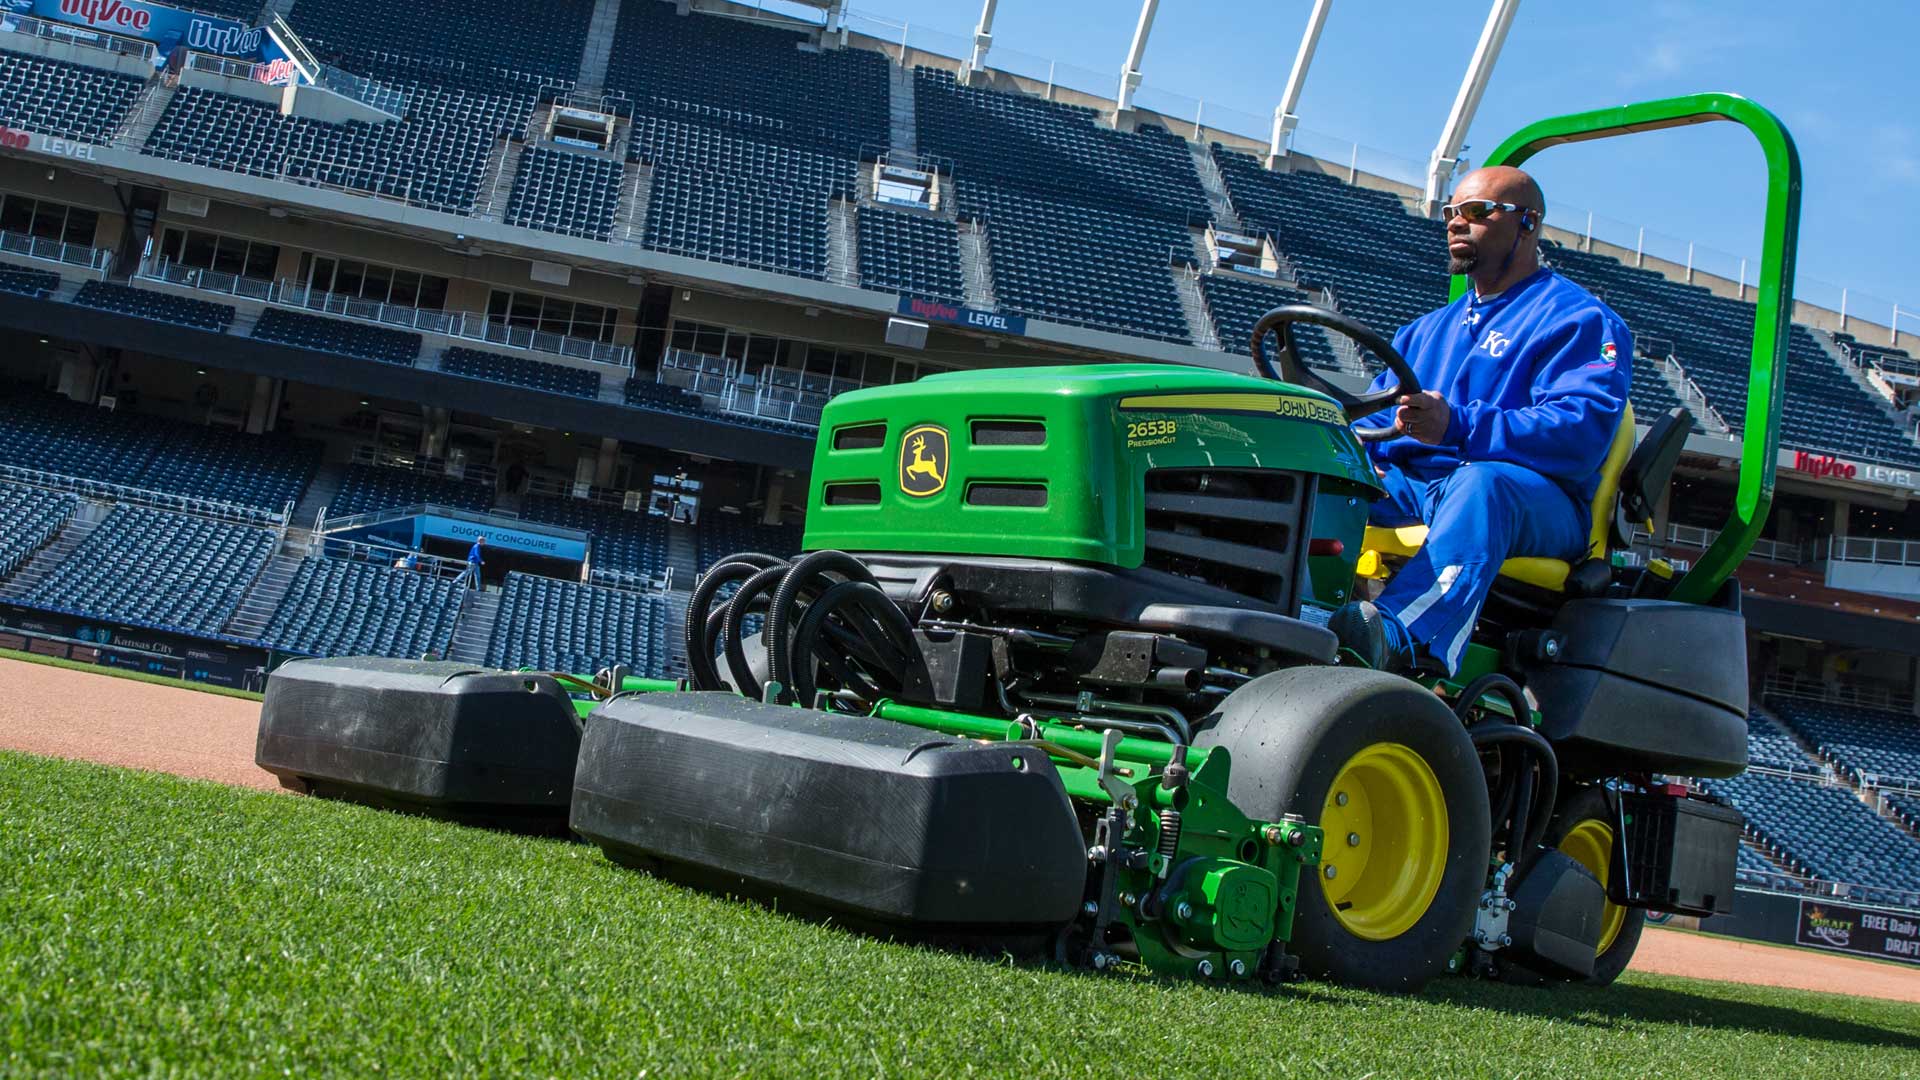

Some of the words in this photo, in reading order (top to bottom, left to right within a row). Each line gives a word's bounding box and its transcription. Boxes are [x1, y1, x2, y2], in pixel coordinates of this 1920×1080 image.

[41, 136, 97, 160] LEVEL
[967, 311, 1008, 330] LEVEL
[1480, 330, 1510, 357] KC
[1275, 396, 1307, 418] JOHN
[1127, 420, 1177, 439] 2653B
[1865, 465, 1915, 486] LEVEL
[451, 524, 494, 541] DUGOUT
[495, 532, 557, 551] CONCOURSE
[113, 635, 150, 650] Kansas
[152, 641, 175, 655] City
[1861, 914, 1889, 932] FREE
[1889, 918, 1918, 937] Daily
[1885, 937, 1920, 956] DRAFT
